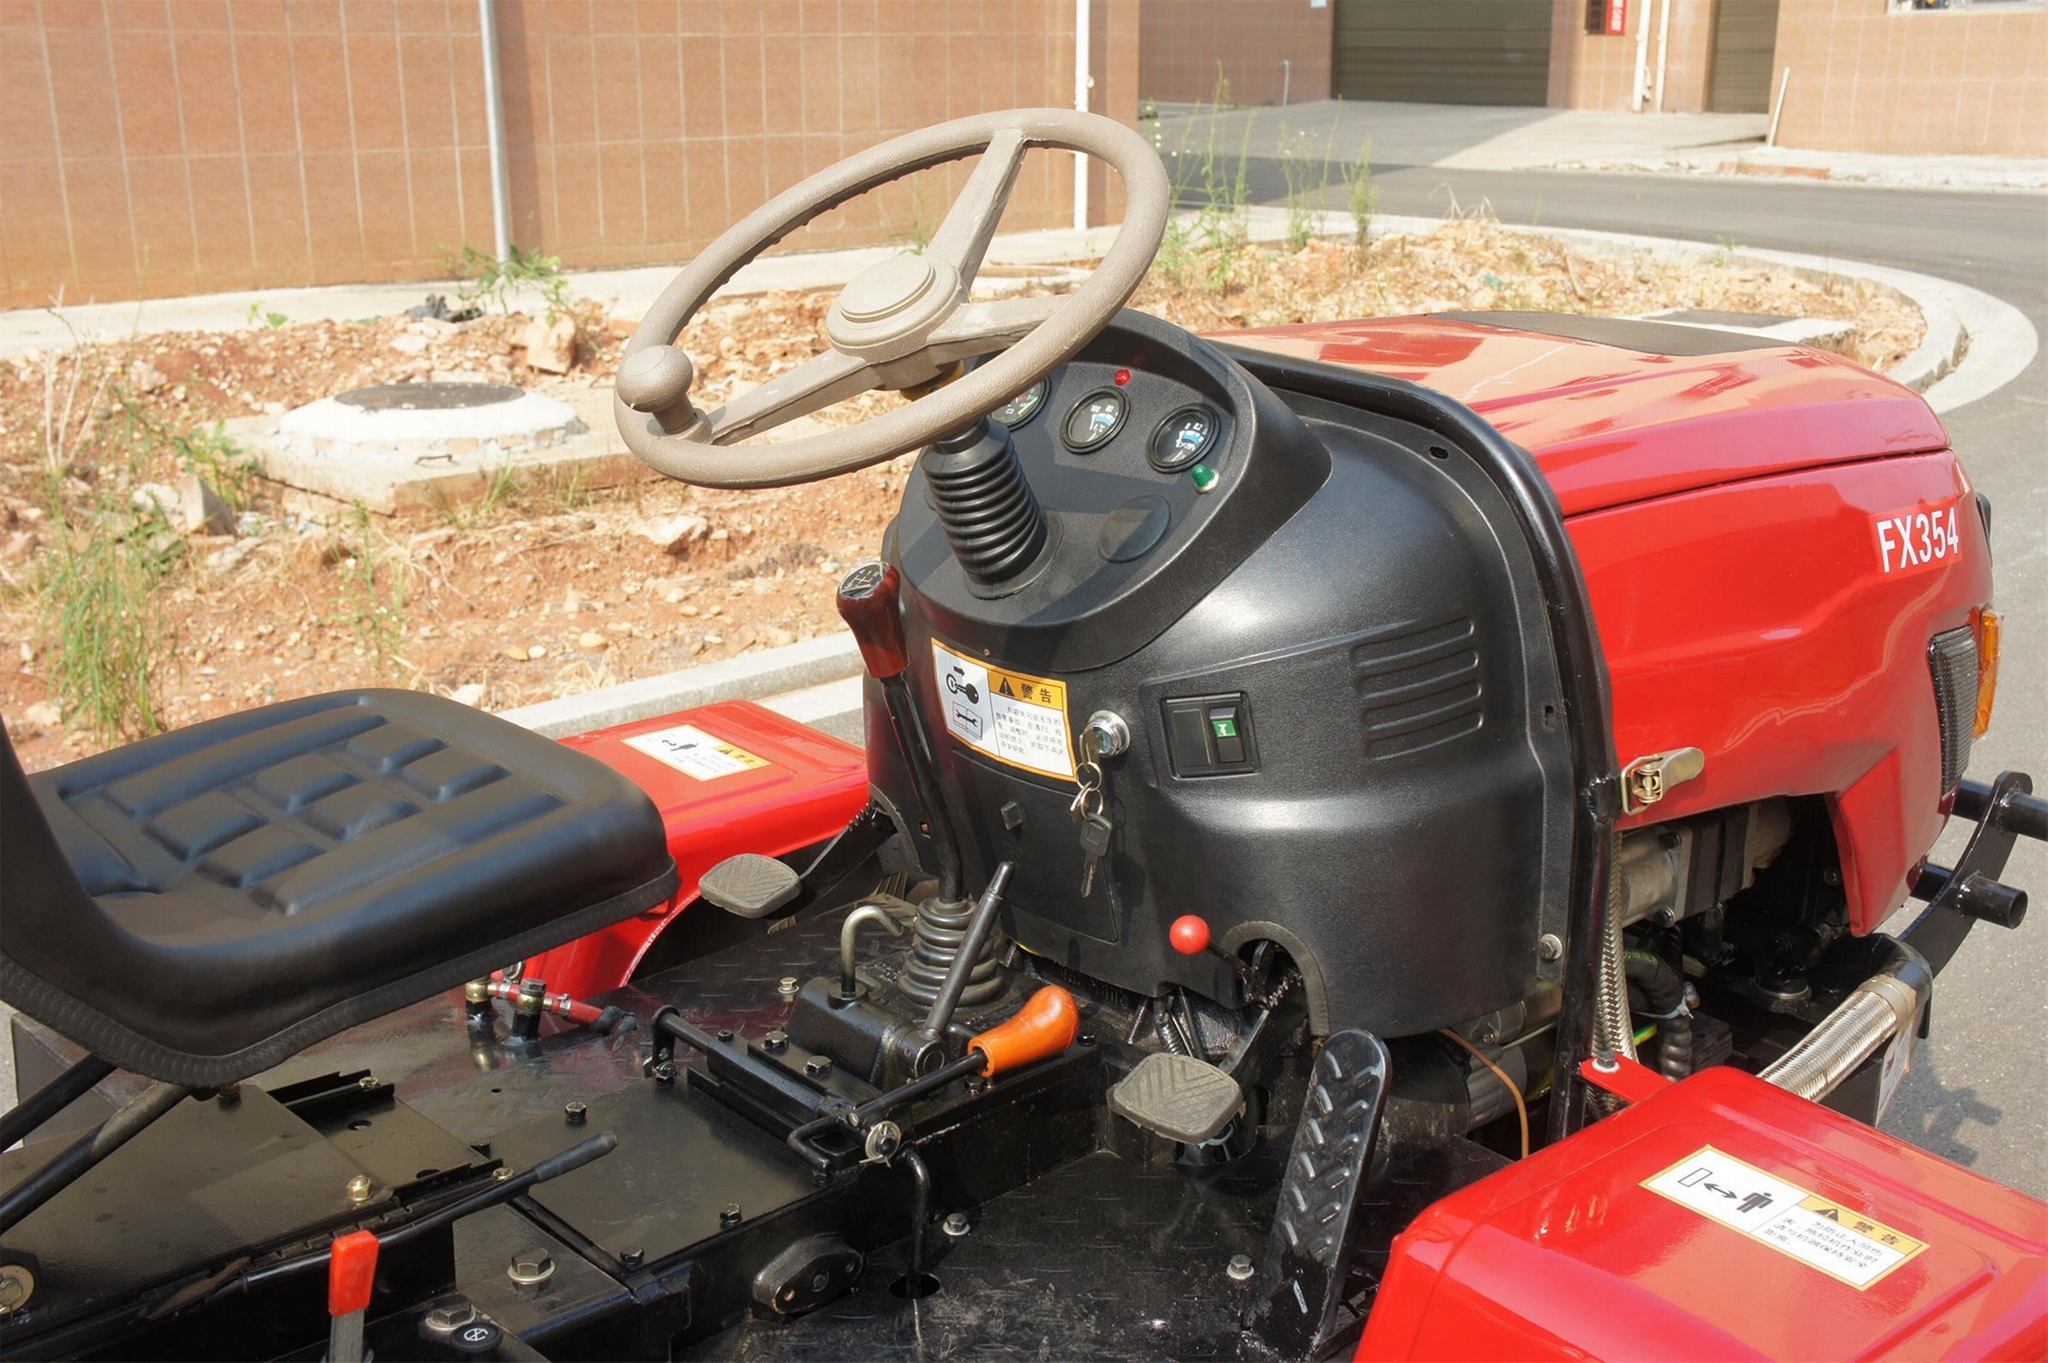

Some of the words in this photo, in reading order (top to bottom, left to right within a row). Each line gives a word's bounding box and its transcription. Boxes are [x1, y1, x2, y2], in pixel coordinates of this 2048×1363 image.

[1877, 507, 1959, 573] FX354
[1020, 683, 1052, 704] 警告
[1853, 1220, 1900, 1246] 警告
